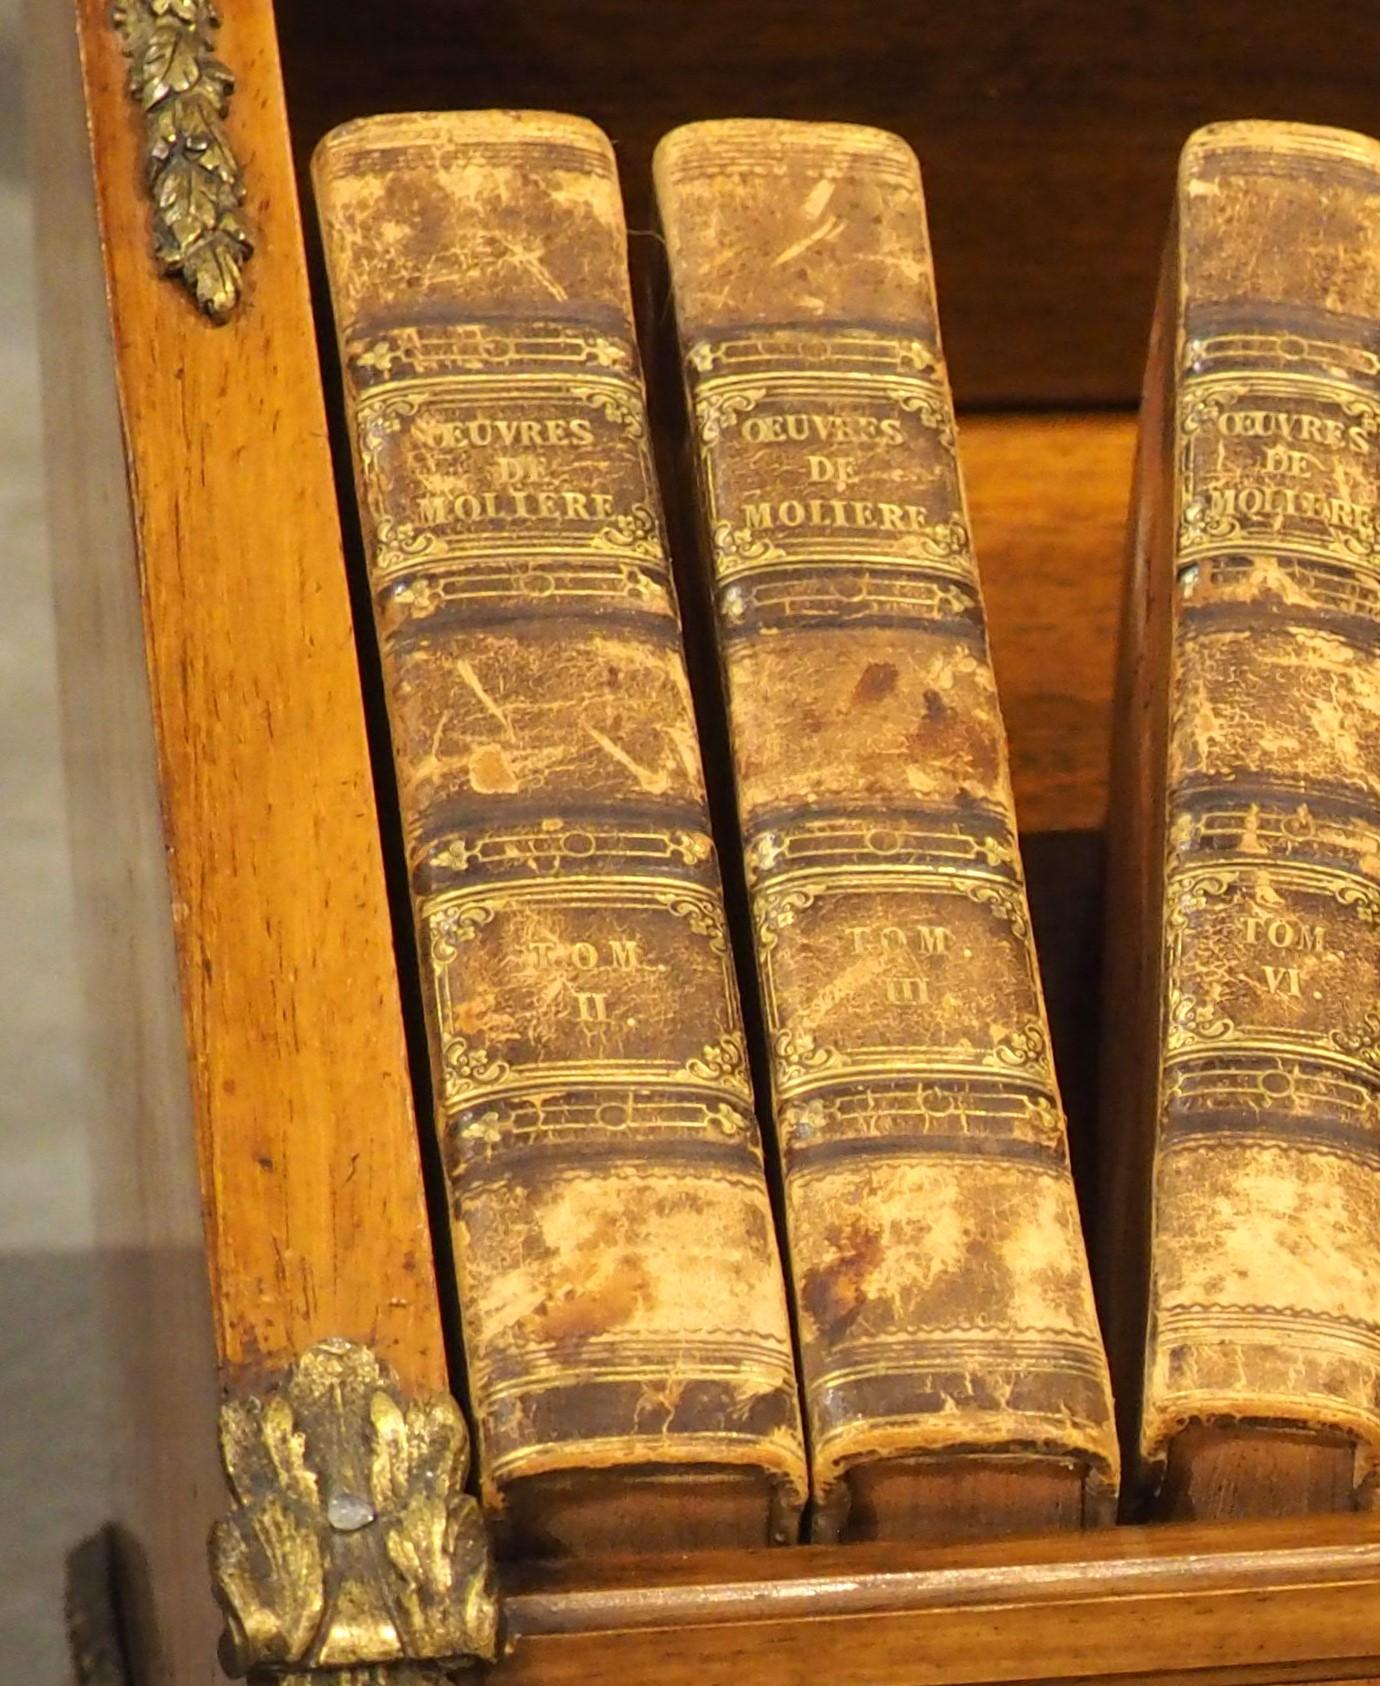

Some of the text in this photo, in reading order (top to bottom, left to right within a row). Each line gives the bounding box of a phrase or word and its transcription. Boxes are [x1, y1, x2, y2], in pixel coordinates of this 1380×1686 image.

[741, 413, 905, 446] ŒUVRES
[1218, 410, 1371, 454] ŒUVRES
[496, 455, 548, 484] DE
[807, 455, 858, 482] DE
[1261, 444, 1312, 478] DE
[1262, 964, 1324, 1000] VI.
